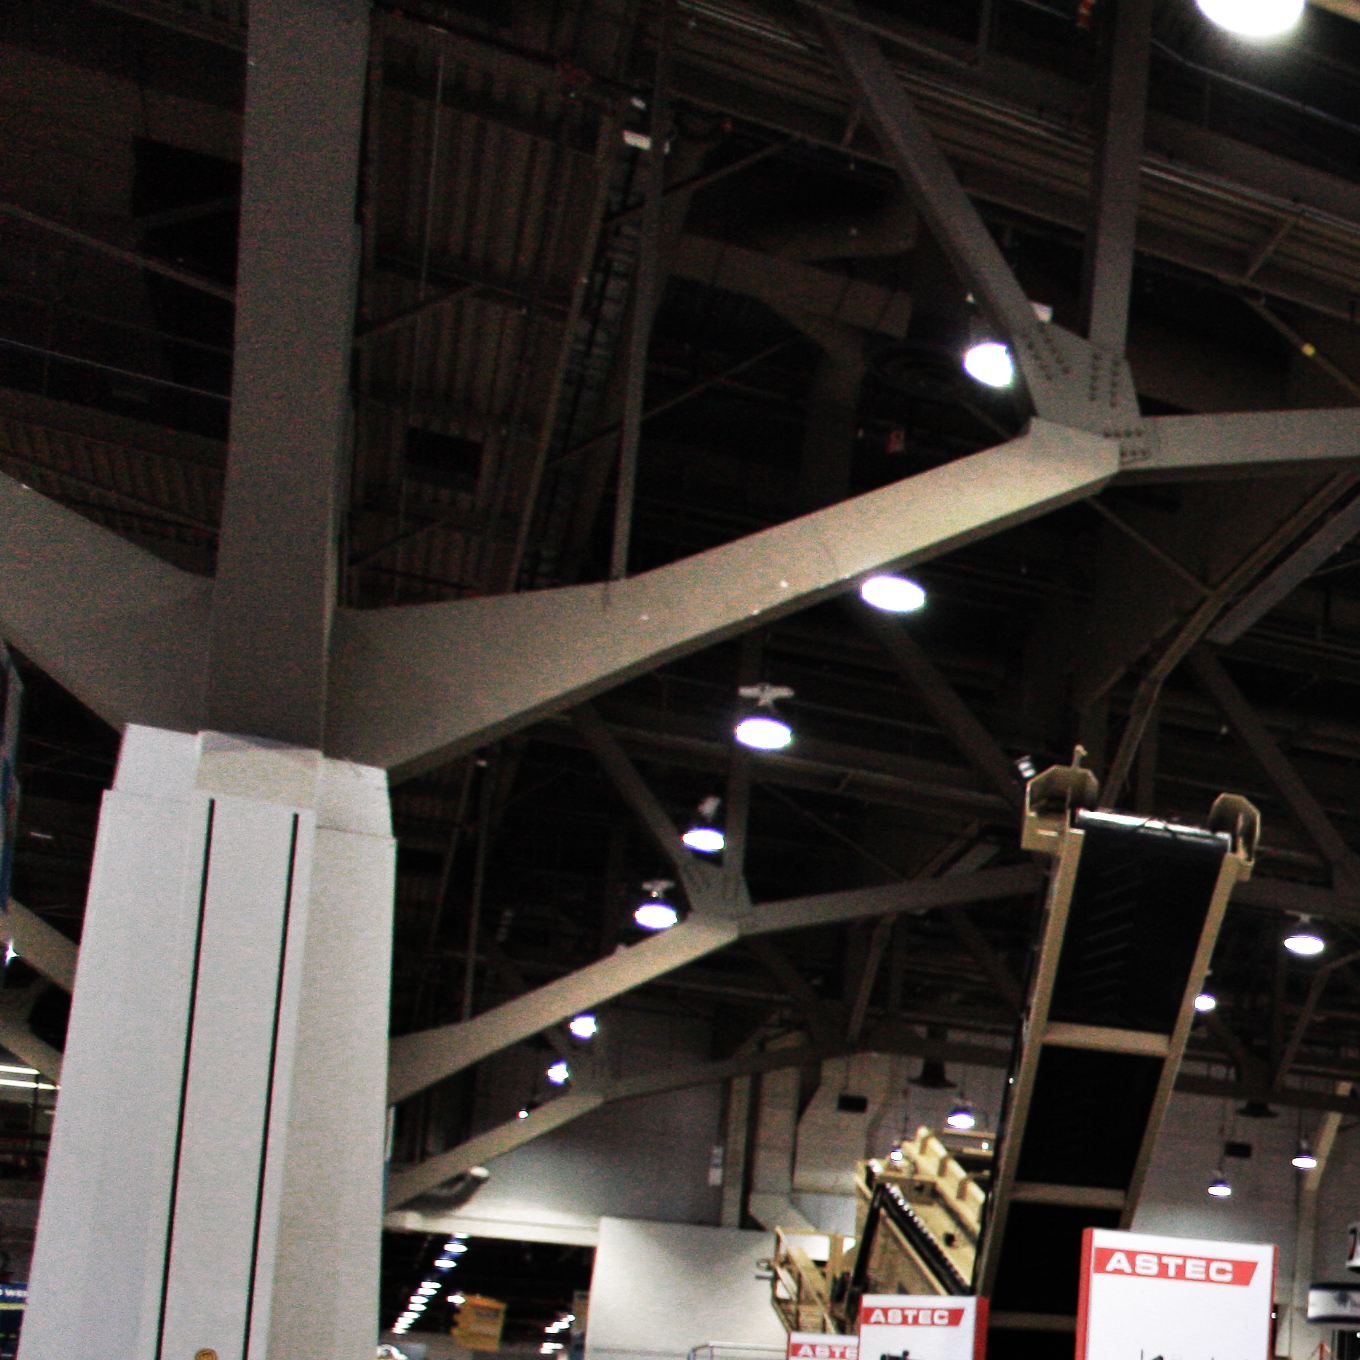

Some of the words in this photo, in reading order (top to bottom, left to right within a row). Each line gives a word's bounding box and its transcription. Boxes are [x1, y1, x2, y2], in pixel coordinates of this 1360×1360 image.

[1105, 1251, 1234, 1283] ASTEC
[869, 1308, 951, 1326] ASTEC
[797, 1344, 859, 1359] ASTE
